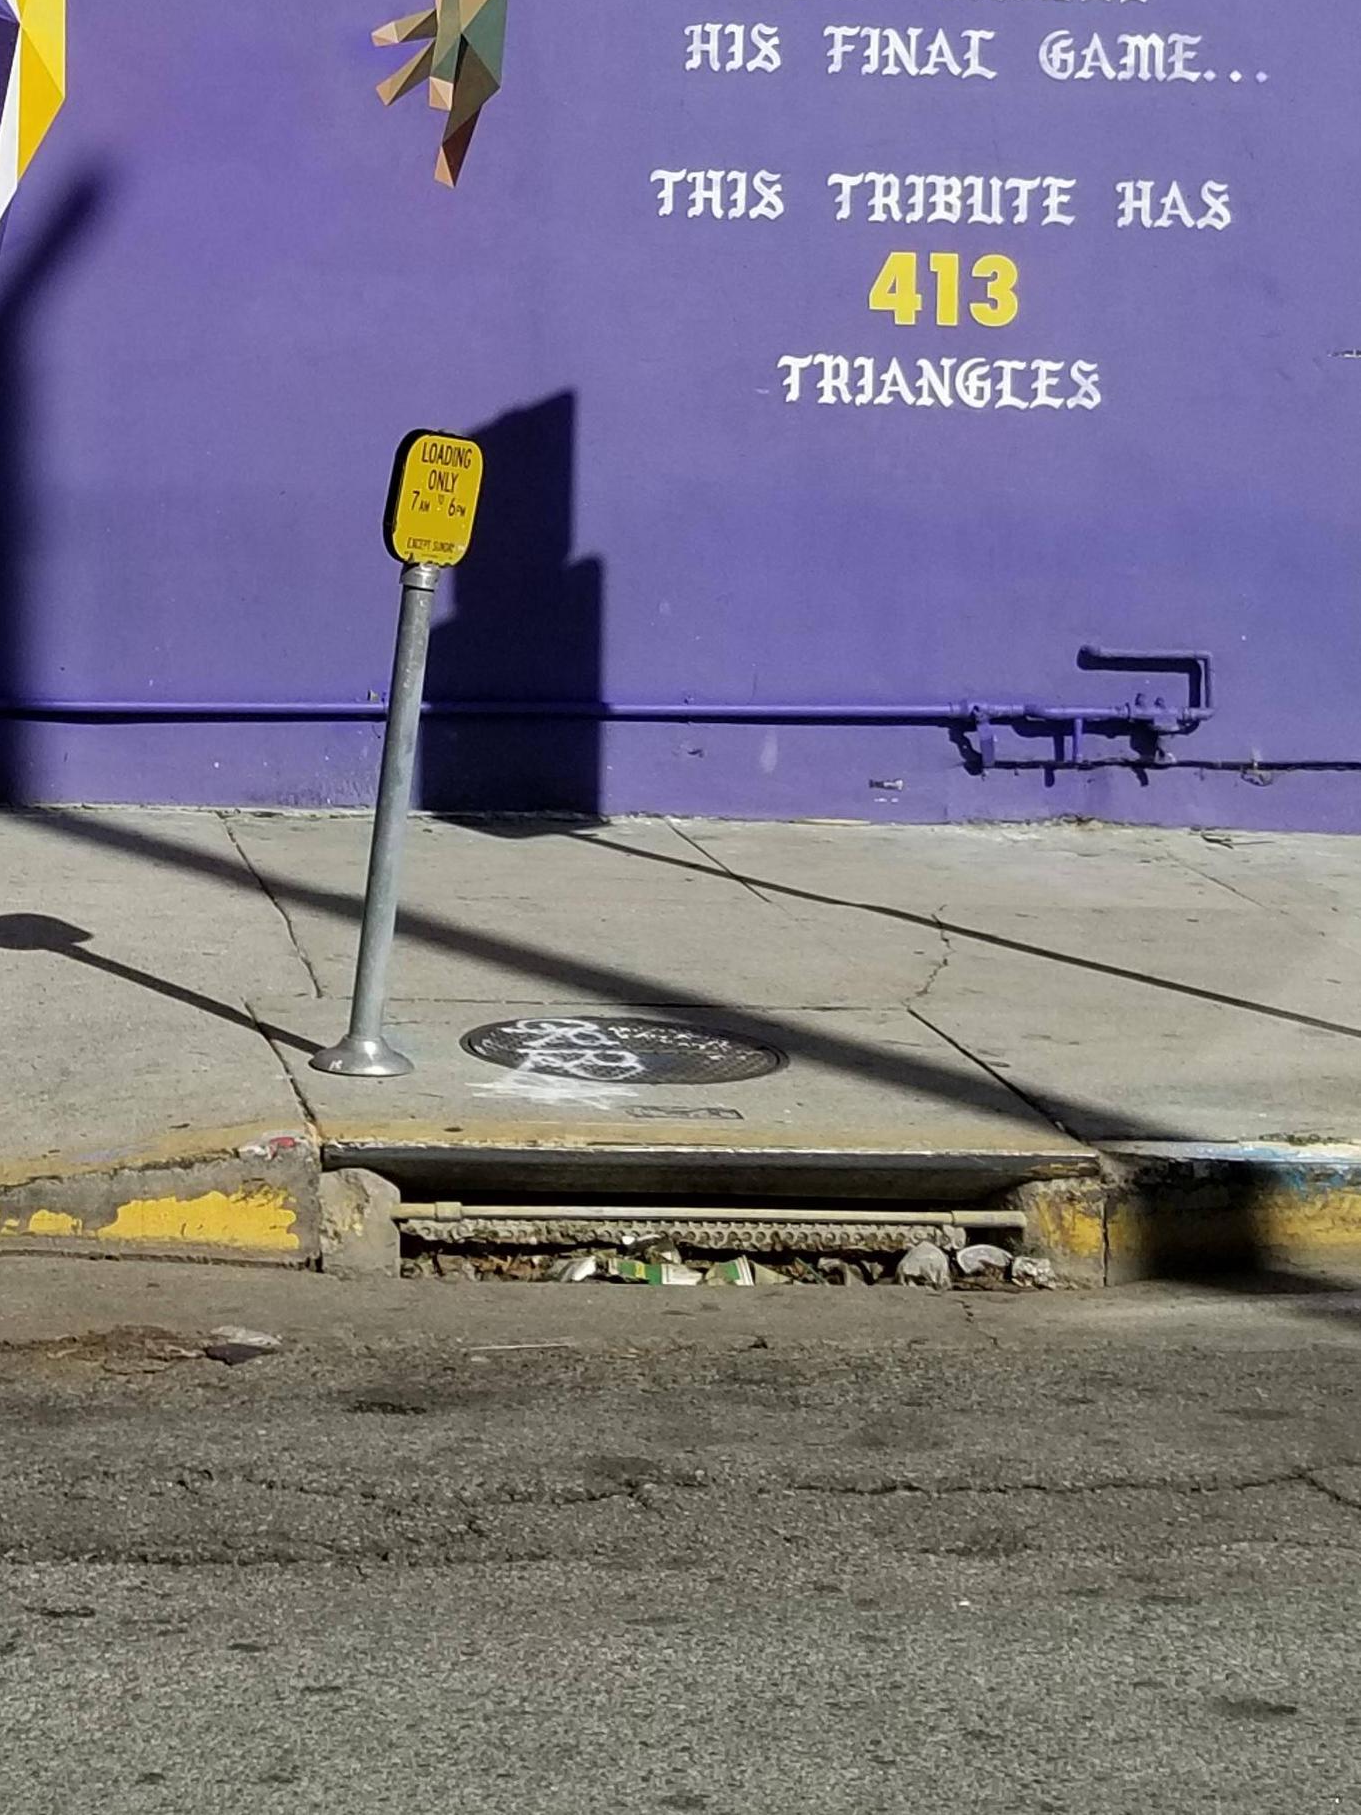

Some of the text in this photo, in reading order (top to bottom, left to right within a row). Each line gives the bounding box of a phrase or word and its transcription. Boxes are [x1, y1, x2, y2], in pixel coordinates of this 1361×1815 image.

[684, 23, 1269, 82] HIS FINAL GAME...
[649, 169, 1233, 230] THIS TRIBUTE HAS
[868, 252, 1018, 326] 413
[777, 353, 1102, 410] TRIANGLES
[421, 441, 473, 469] LOADING
[428, 469, 459, 493] ONLY
